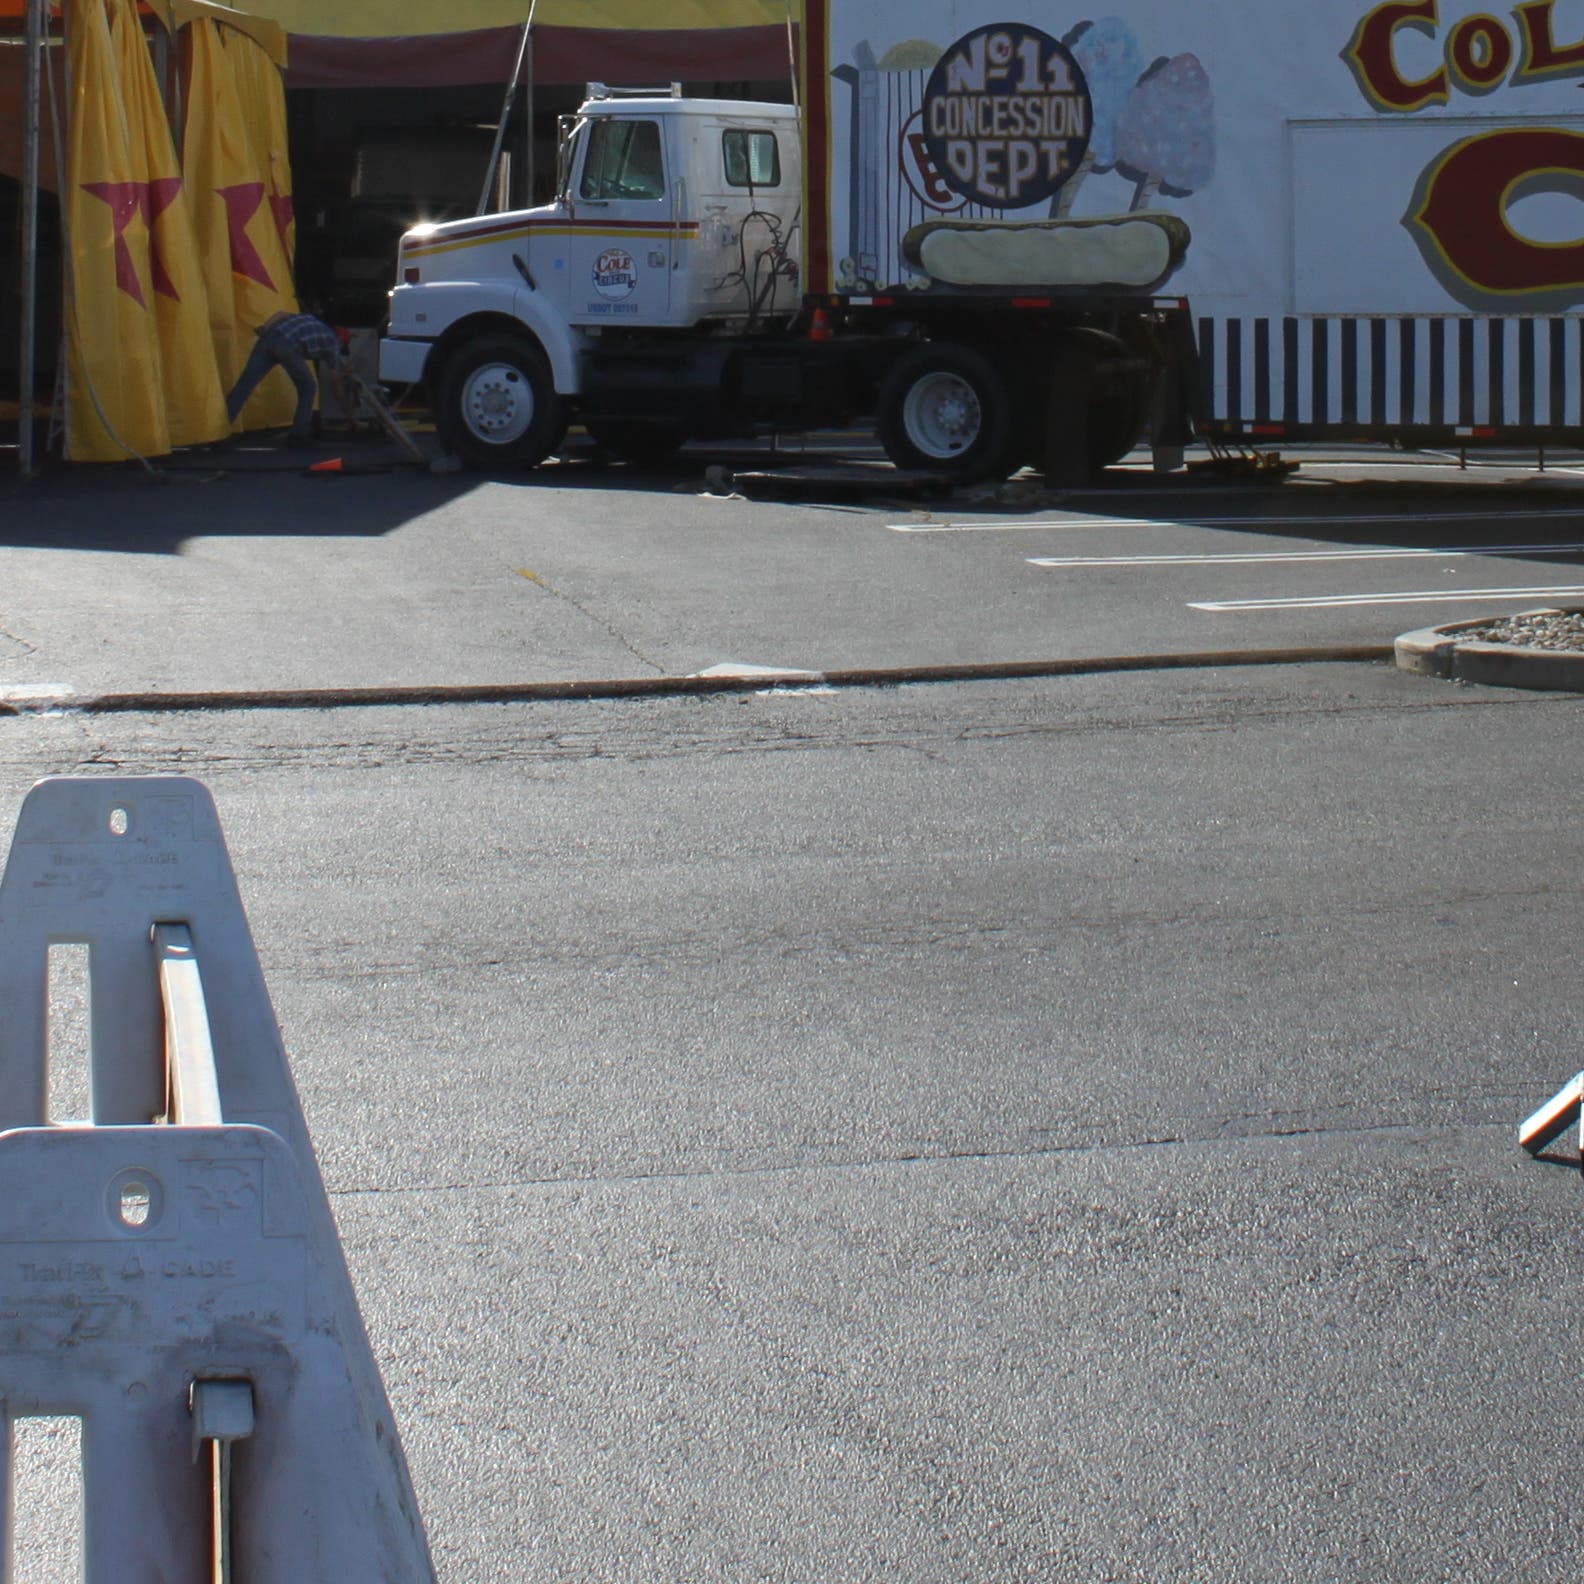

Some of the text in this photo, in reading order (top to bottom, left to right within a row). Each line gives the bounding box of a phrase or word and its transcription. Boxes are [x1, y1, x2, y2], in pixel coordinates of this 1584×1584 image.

[1019, 36, 1076, 92] 11
[930, 95, 1086, 138] CONCESSION
[946, 139, 1071, 200] DEPT.
